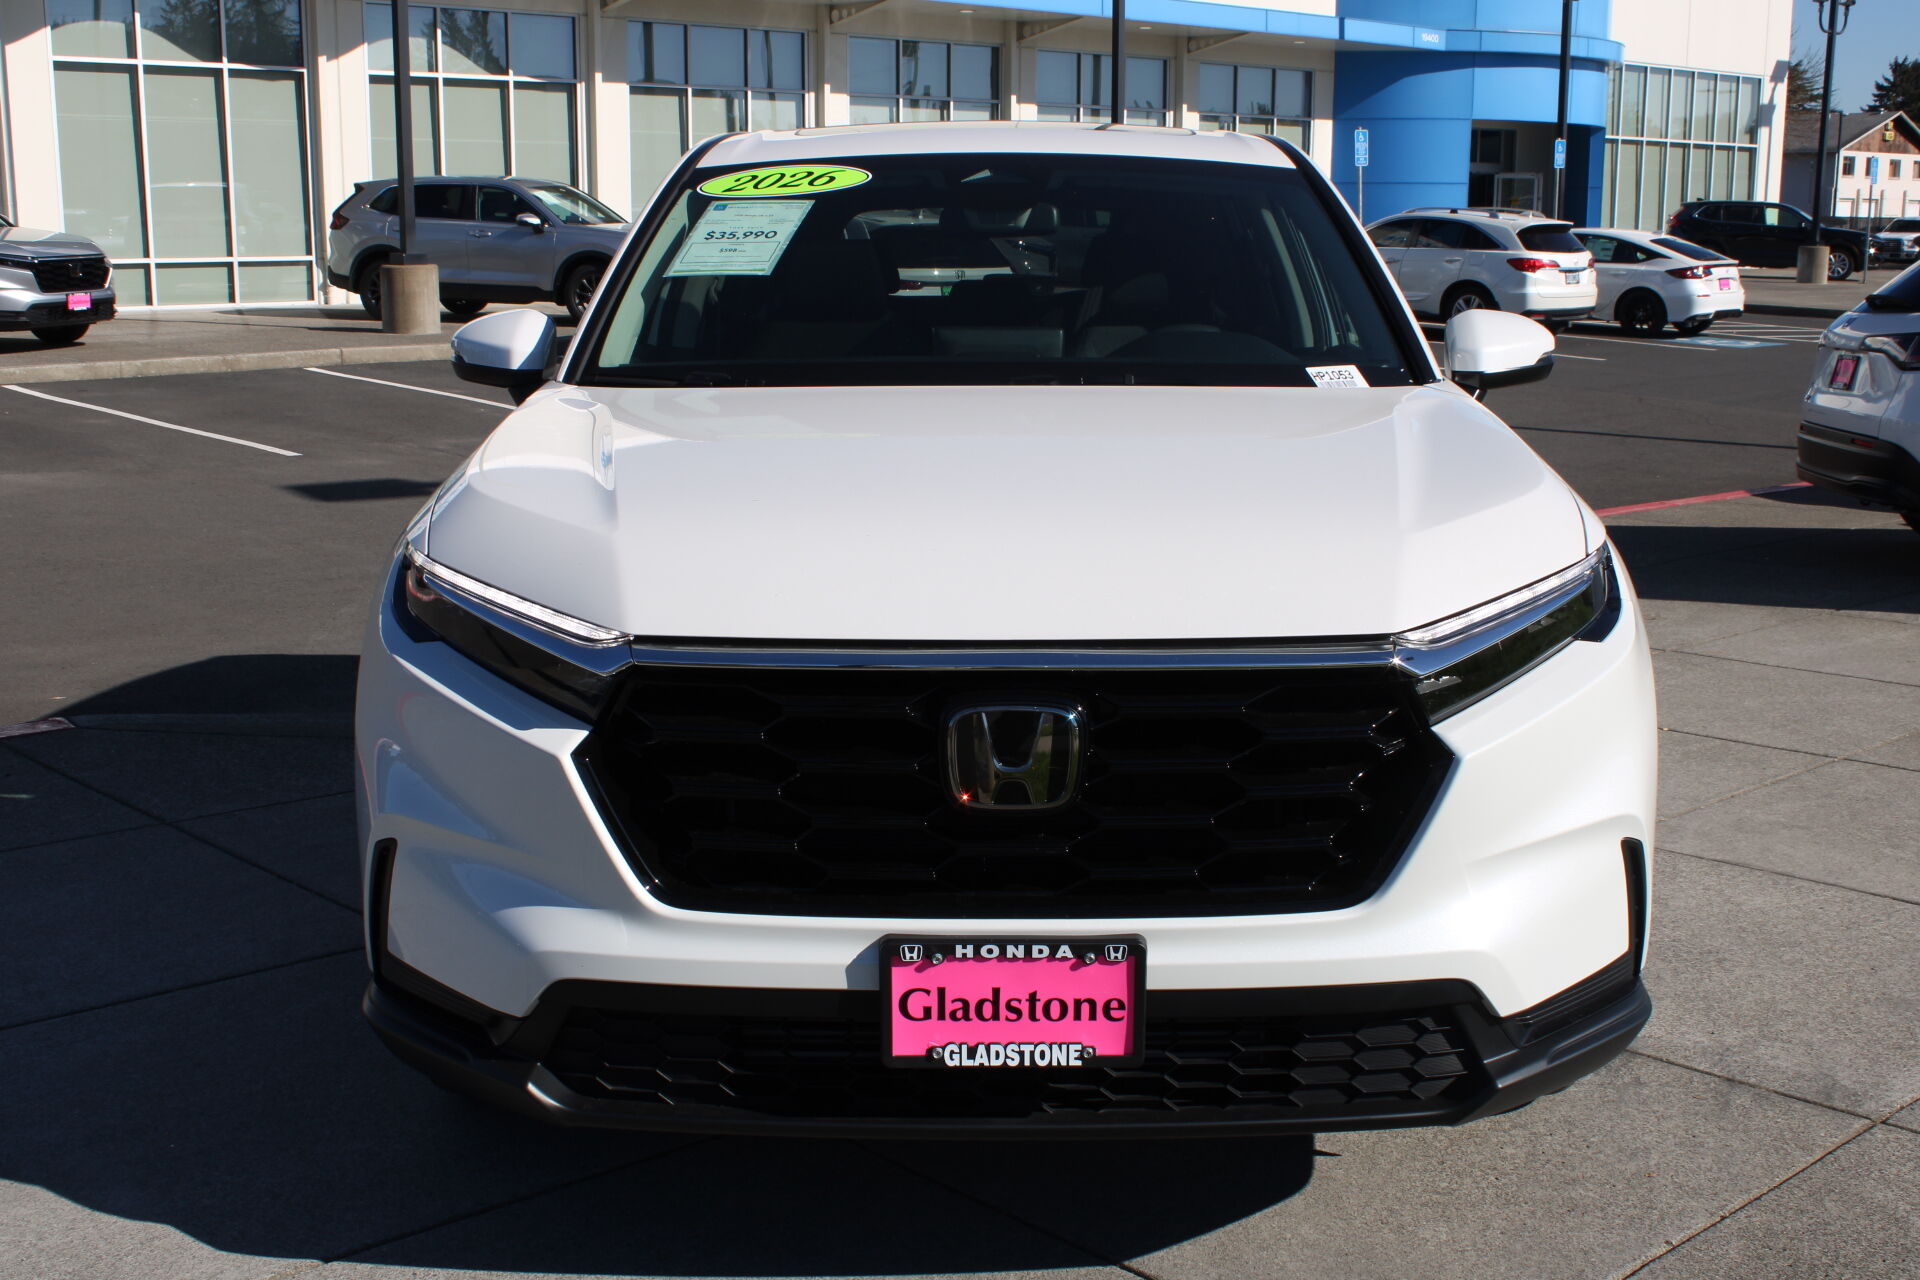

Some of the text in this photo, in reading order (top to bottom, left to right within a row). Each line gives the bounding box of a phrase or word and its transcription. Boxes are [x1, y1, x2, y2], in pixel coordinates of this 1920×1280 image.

[721, 169, 847, 193] 2026
[704, 230, 778, 241] $35,990
[1311, 370, 1354, 380] HP1053
[955, 944, 1074, 959] HONDA
[898, 987, 1126, 1022] Gladstone
[943, 1043, 1083, 1067] GLADSTONE
